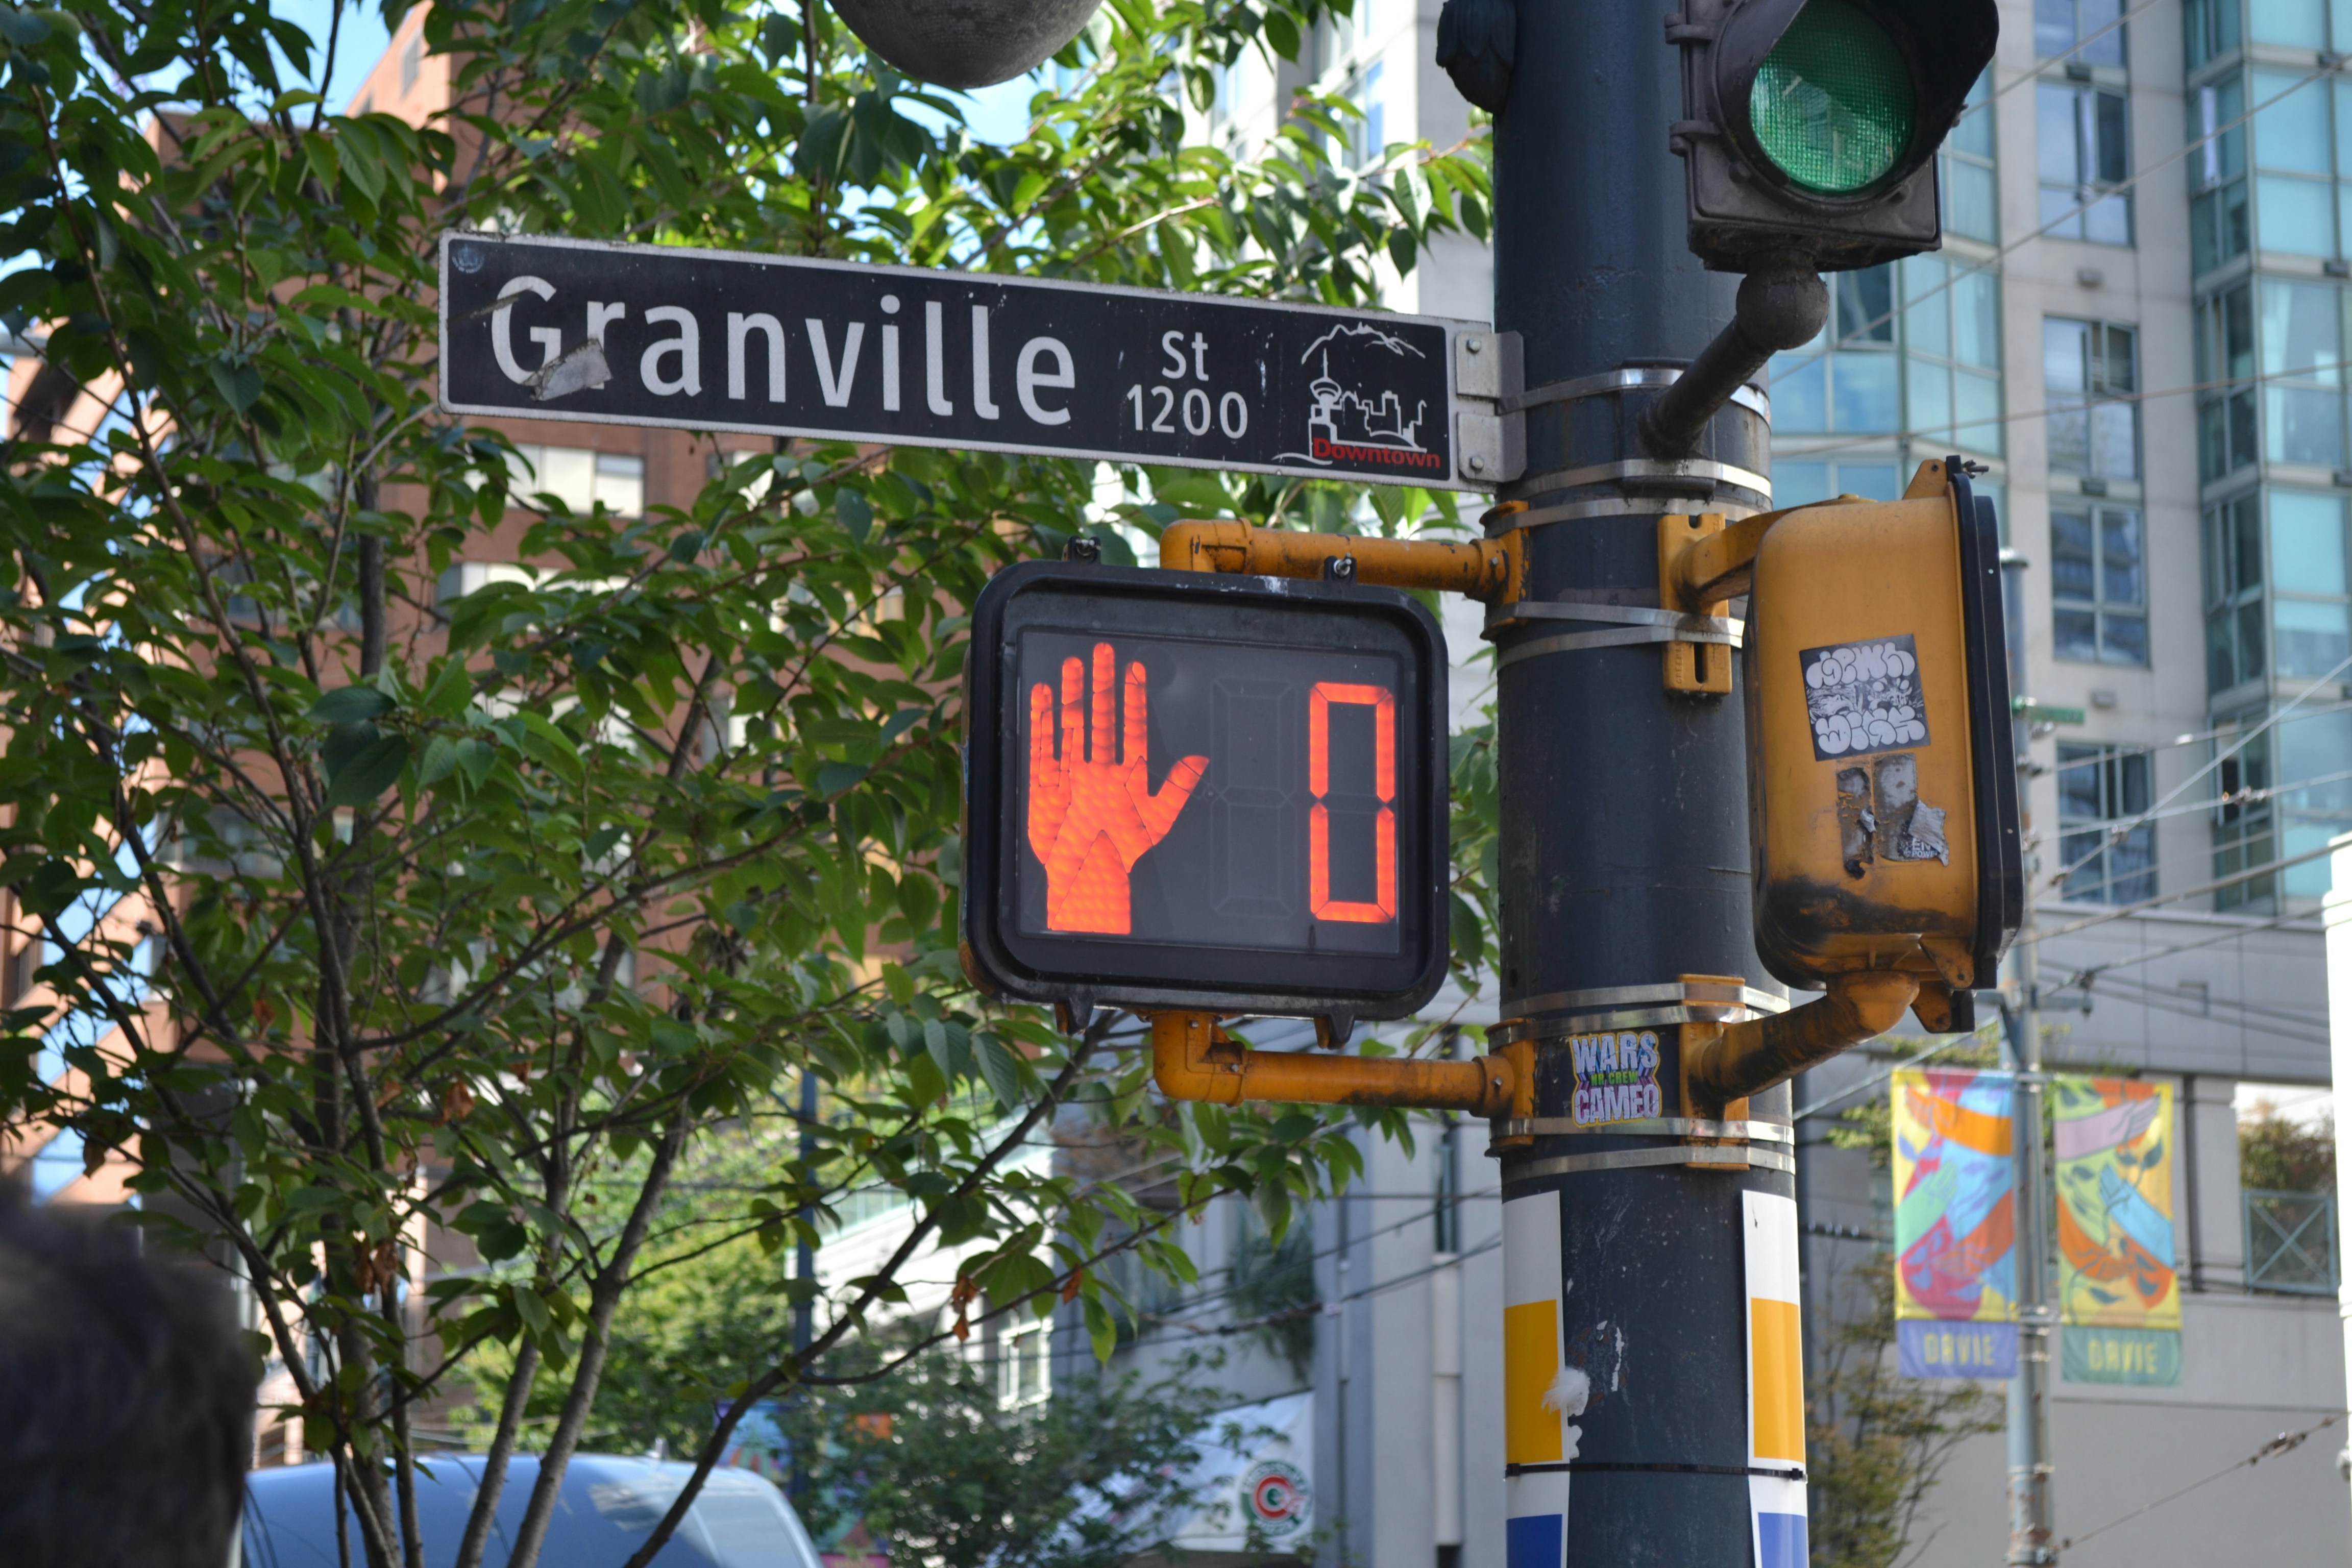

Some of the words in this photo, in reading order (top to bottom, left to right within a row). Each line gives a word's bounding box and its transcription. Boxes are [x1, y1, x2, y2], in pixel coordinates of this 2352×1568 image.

[491, 275, 1075, 427] Granville
[1161, 330, 1210, 382] St
[1125, 383, 1248, 439] 1200
[1312, 436, 1441, 469] Downtown
[1572, 1033, 1659, 1075] WARS
[1608, 1070, 1638, 1085] CREW
[1575, 1084, 1660, 1125] CAMEO
[1923, 1332, 1995, 1366] DAVIE
[2087, 1339, 2158, 1374] DAVIE
